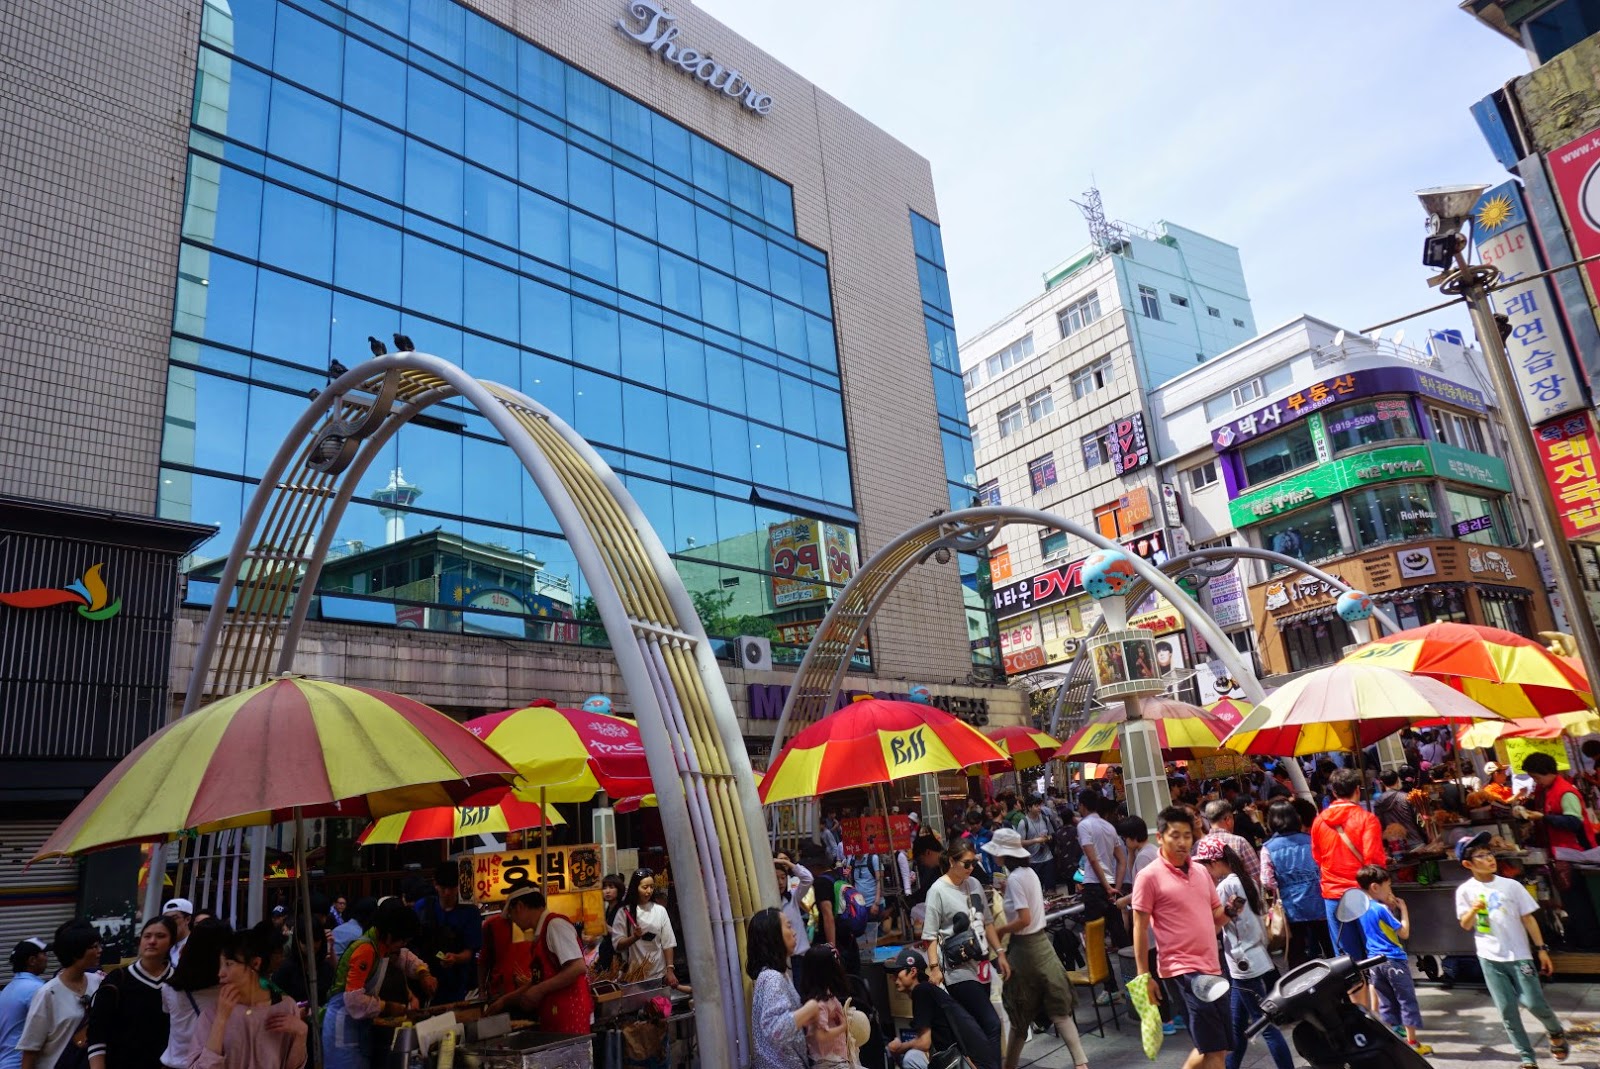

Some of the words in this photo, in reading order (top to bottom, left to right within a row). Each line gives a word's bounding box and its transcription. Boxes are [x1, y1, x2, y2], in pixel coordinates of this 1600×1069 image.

[616, 0, 773, 116] Theatre
[1238, 405, 1282, 436] 박사
[1287, 373, 1356, 411] 부동산
[1117, 420, 1138, 470] DVD
[1548, 434, 1600, 531] 돼지국밥
[991, 557, 1010, 578] 당구
[477, 857, 492, 899] 씨앗
[501, 850, 566, 895] 호떡
